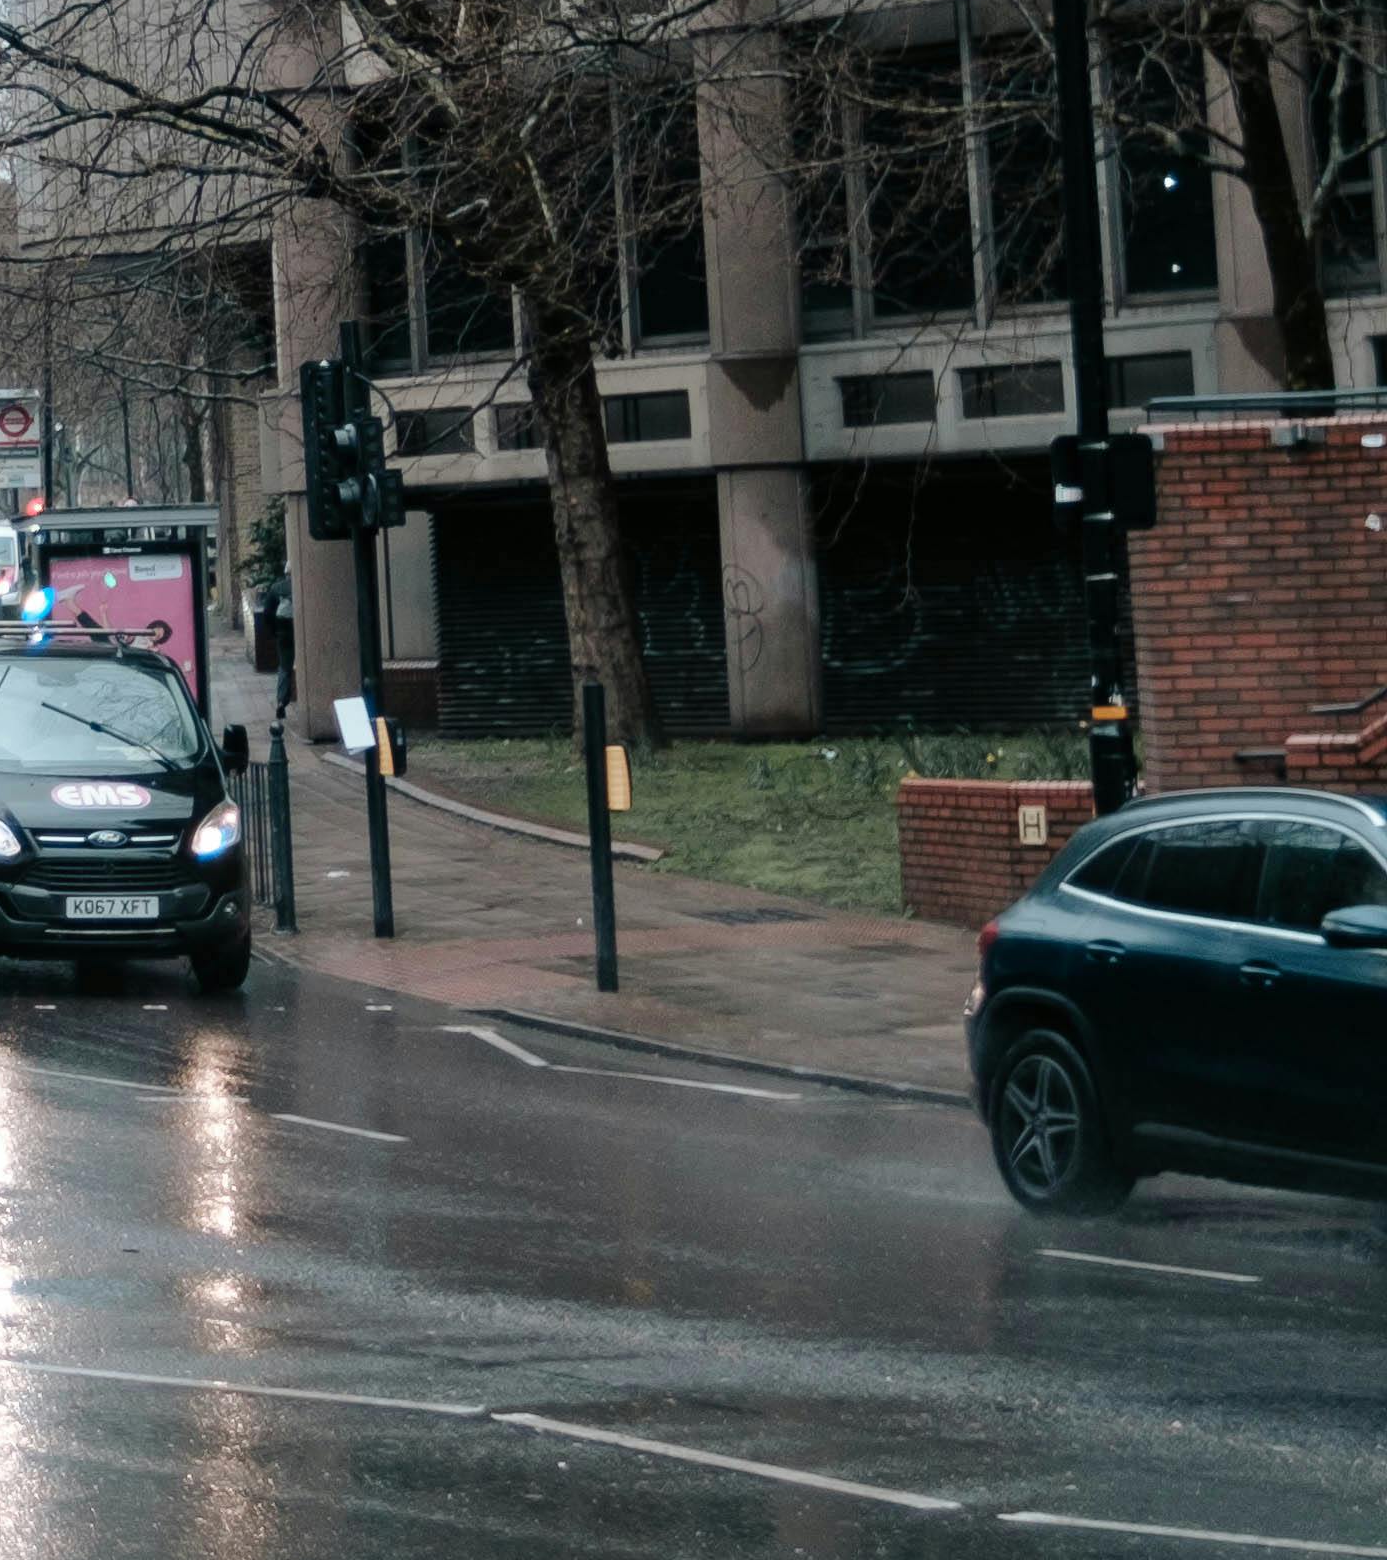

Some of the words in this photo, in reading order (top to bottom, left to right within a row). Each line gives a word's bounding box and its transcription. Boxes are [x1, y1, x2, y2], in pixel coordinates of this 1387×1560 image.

[56, 784, 144, 806] EMS
[1023, 811, 1041, 839] H
[73, 899, 115, 915] KO67
[121, 898, 151, 915] XFT
